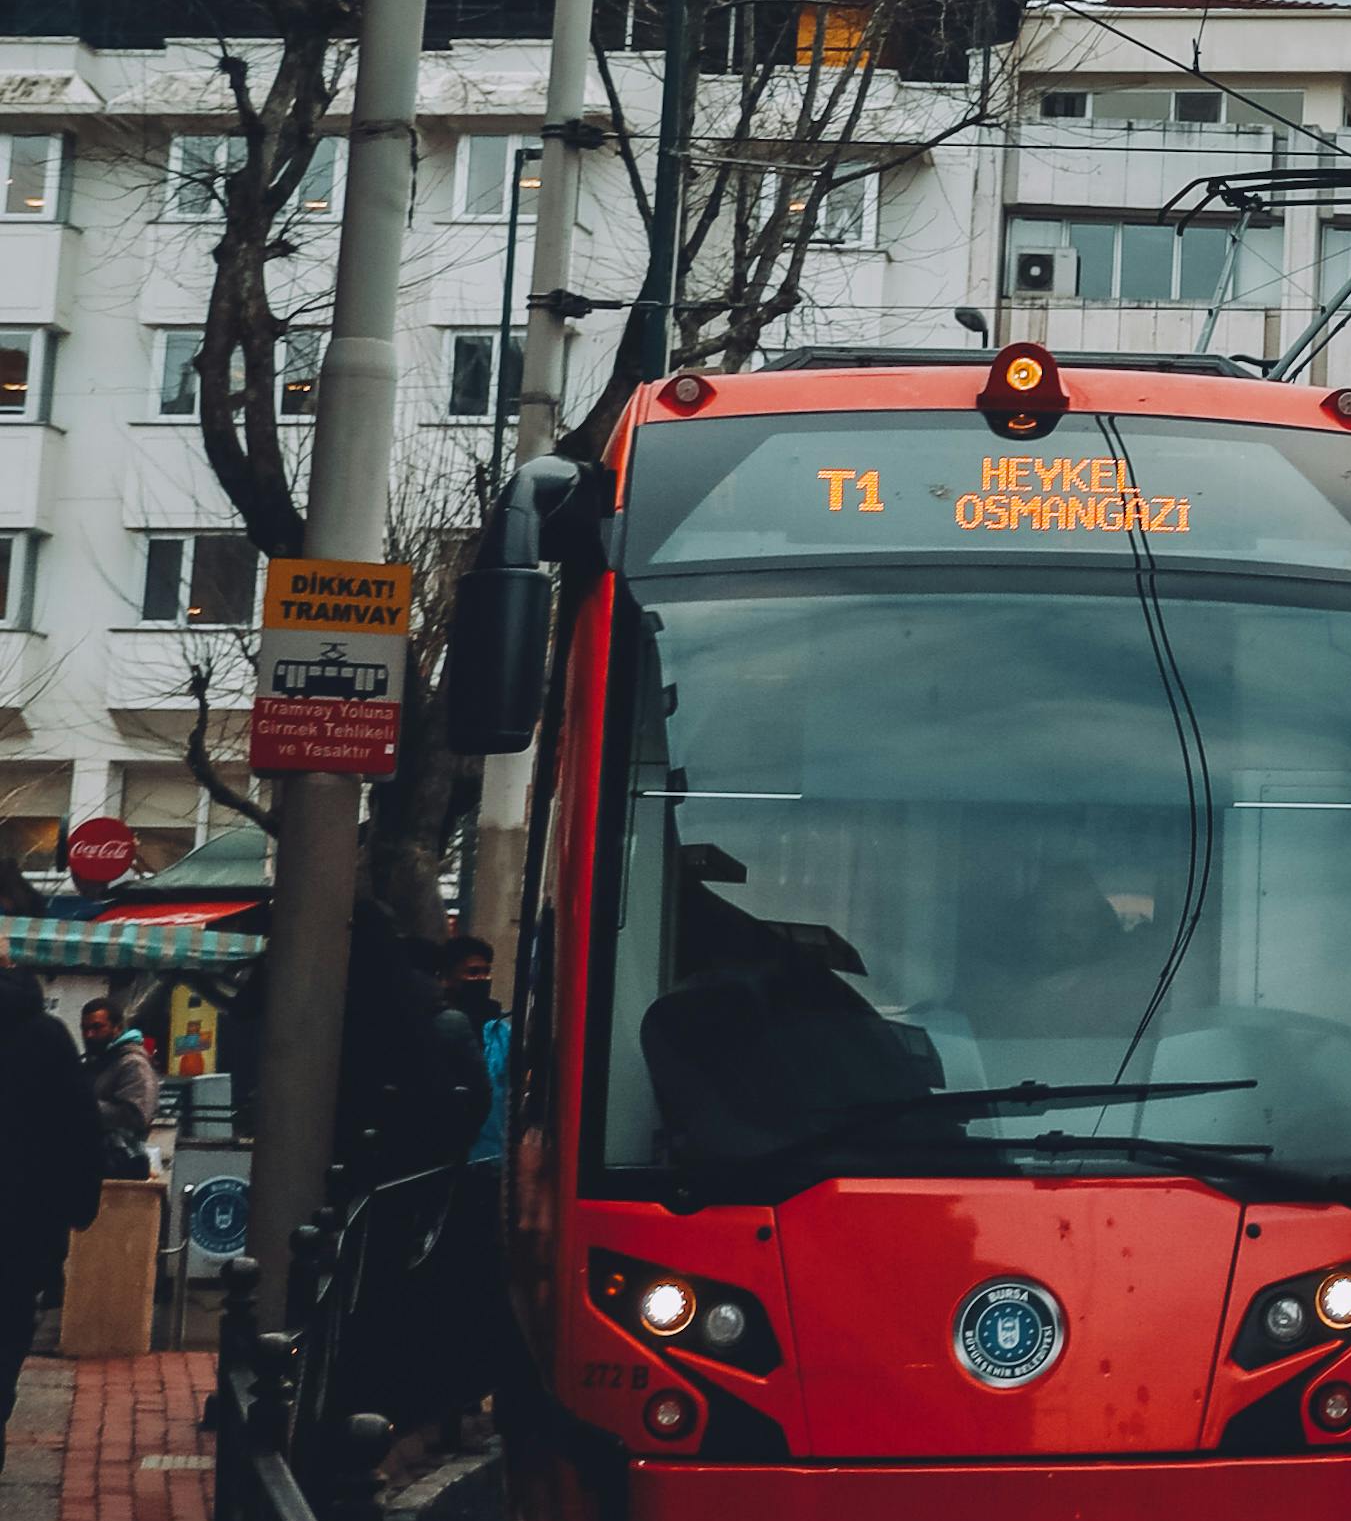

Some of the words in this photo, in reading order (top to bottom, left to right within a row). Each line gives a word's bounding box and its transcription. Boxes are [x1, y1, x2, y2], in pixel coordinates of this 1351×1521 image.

[982, 456, 1141, 494] HEYKEL
[817, 469, 884, 512] T1
[290, 572, 395, 599] DİKKAT!
[281, 600, 404, 626] TRAMVAY
[261, 699, 333, 720] Tramvay
[340, 703, 394, 721] Yoluna
[258, 720, 318, 736] Girmek
[325, 722, 395, 740] Tehlikeli
[278, 743, 297, 756] ve
[988, 1287, 1029, 1303] BURSA
[631, 1363, 649, 1391] B
